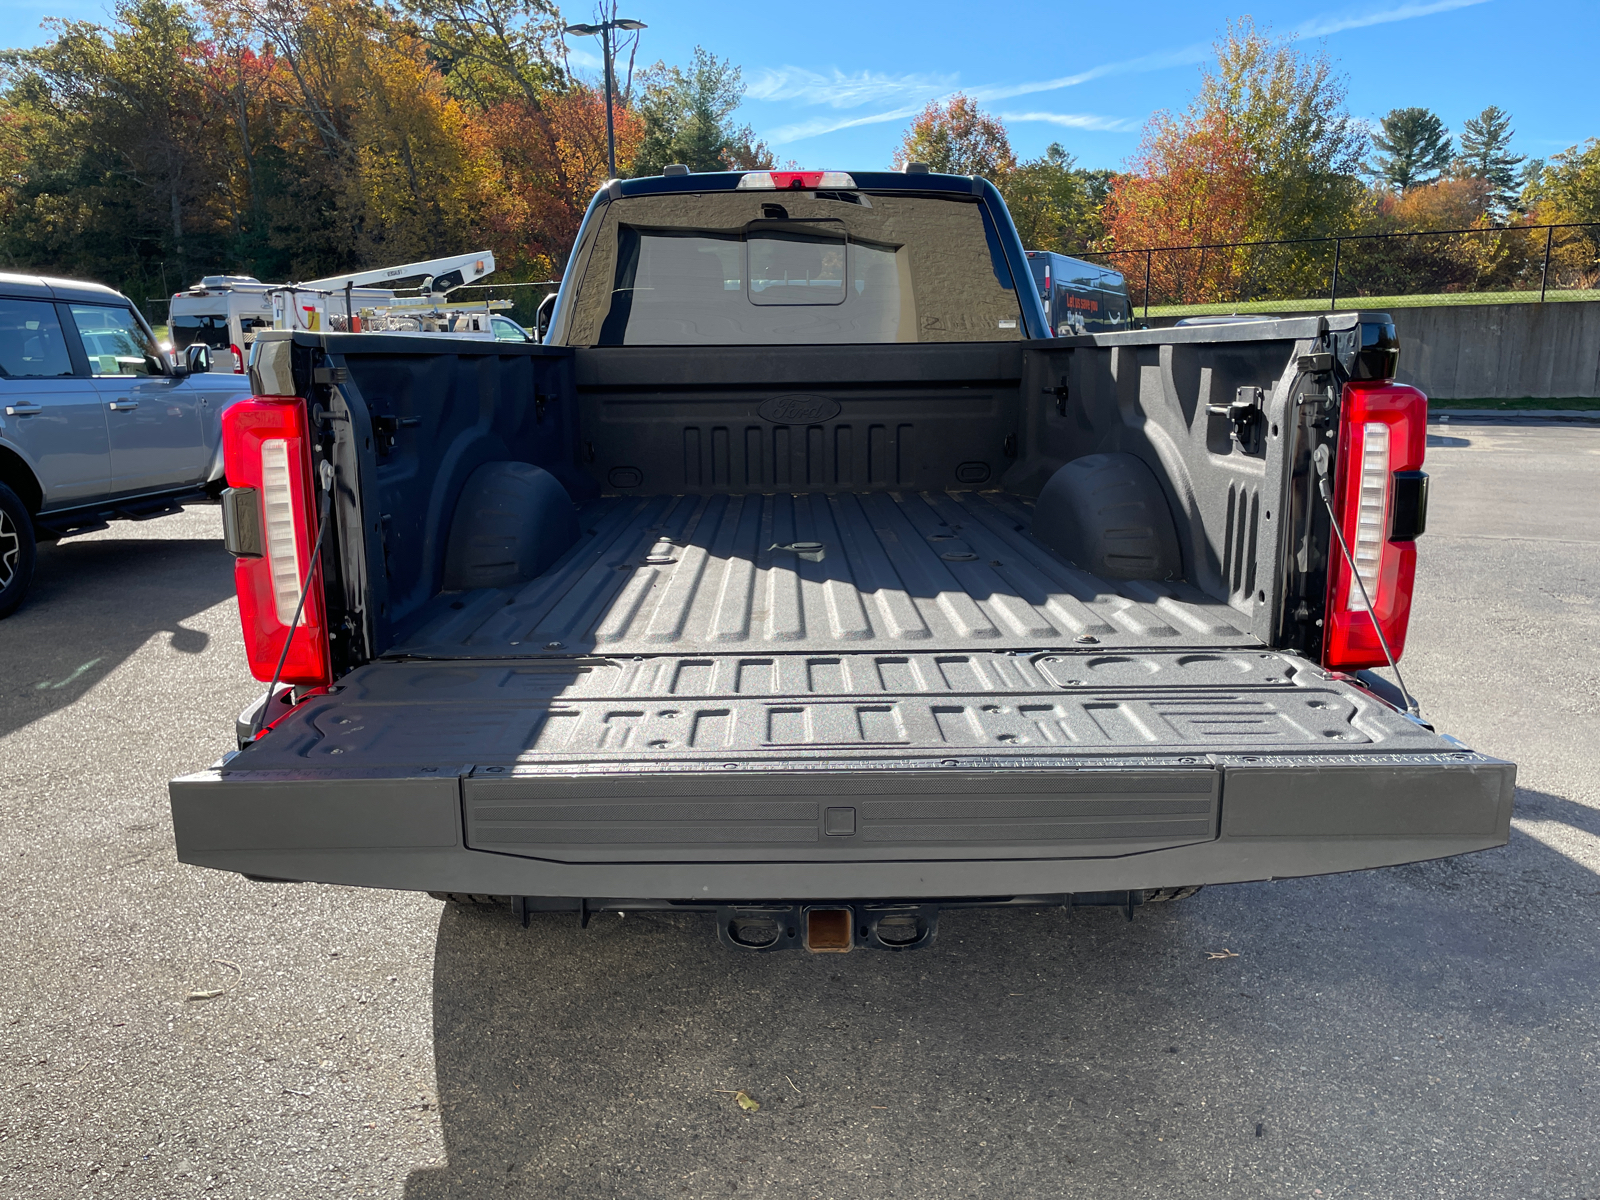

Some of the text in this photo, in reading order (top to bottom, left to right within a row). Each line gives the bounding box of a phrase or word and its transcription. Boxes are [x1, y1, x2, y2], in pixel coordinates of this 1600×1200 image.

[1066, 293, 1098, 313] Let us save you
[772, 399, 824, 420] Ford
